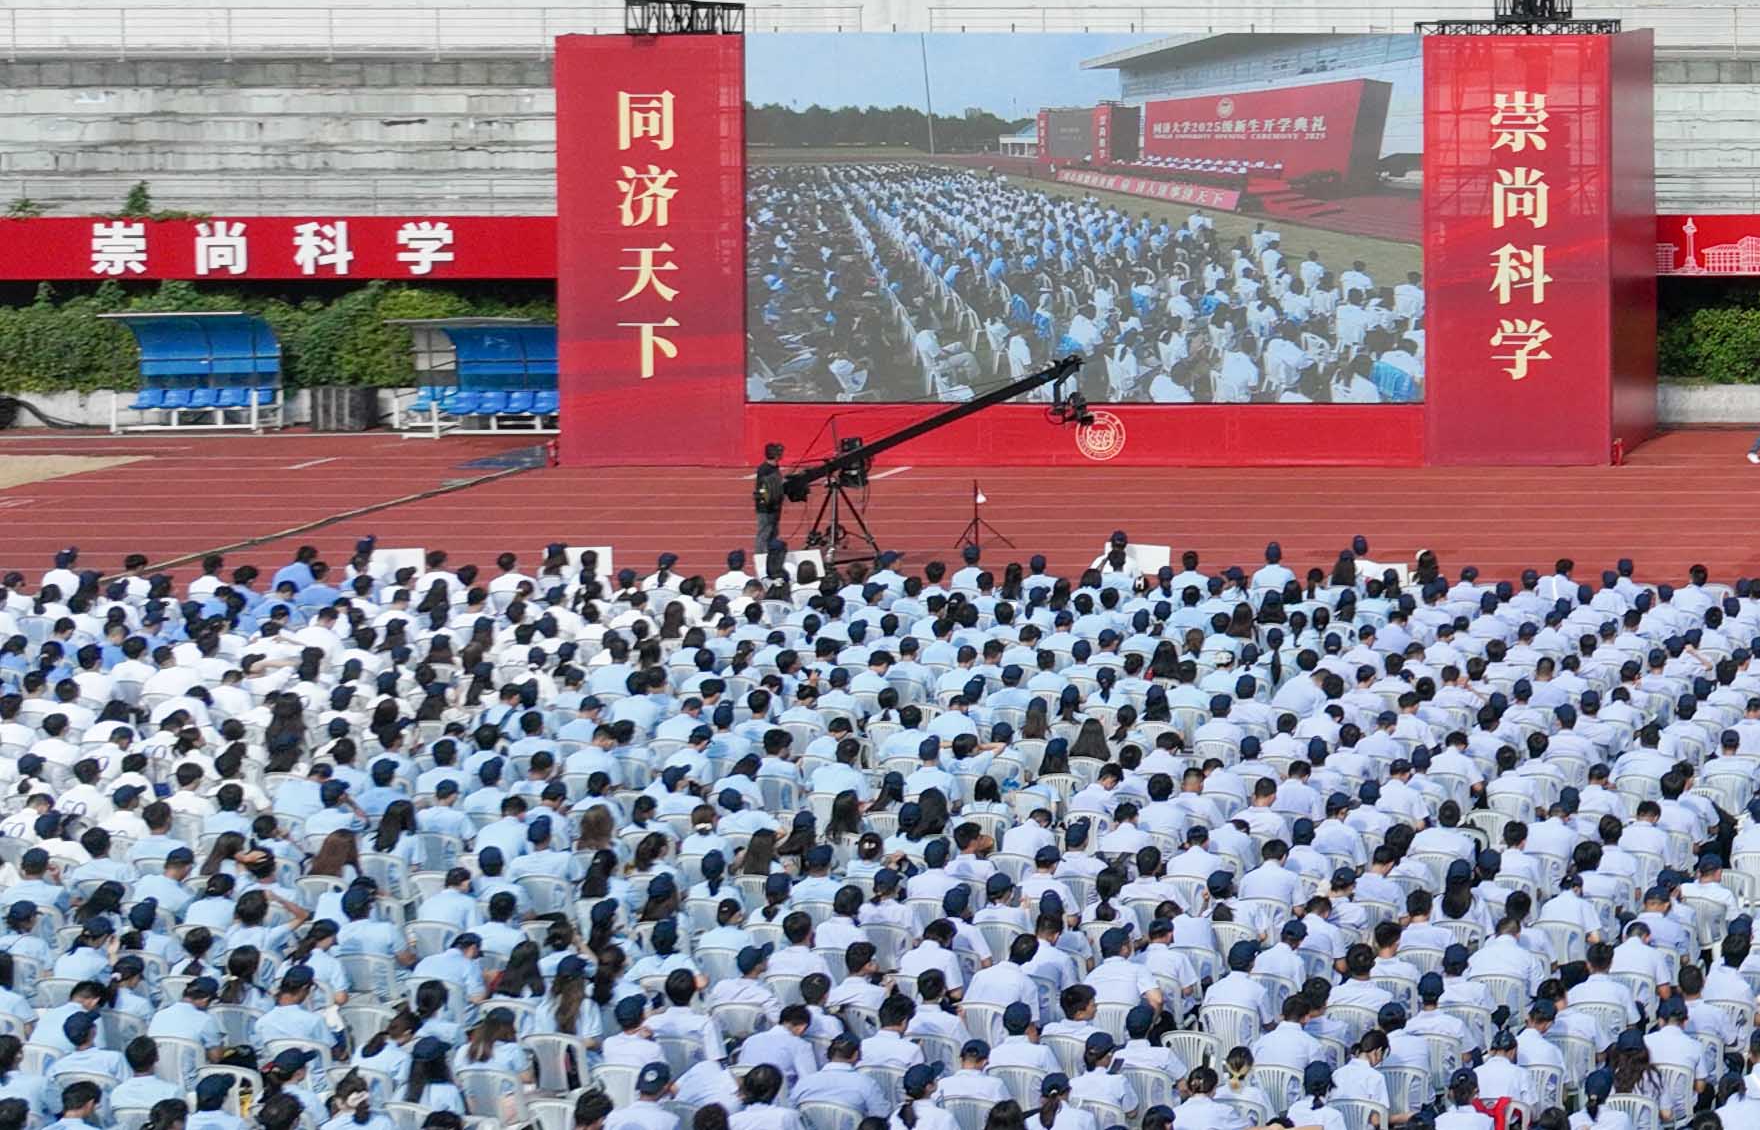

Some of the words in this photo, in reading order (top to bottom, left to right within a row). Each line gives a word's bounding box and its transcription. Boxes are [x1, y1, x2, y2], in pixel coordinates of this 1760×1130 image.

[92, 221, 454, 275] 崇尚科学
[617, 91, 679, 378] 同济天下
[1489, 91, 1553, 380] 崇尚科学
